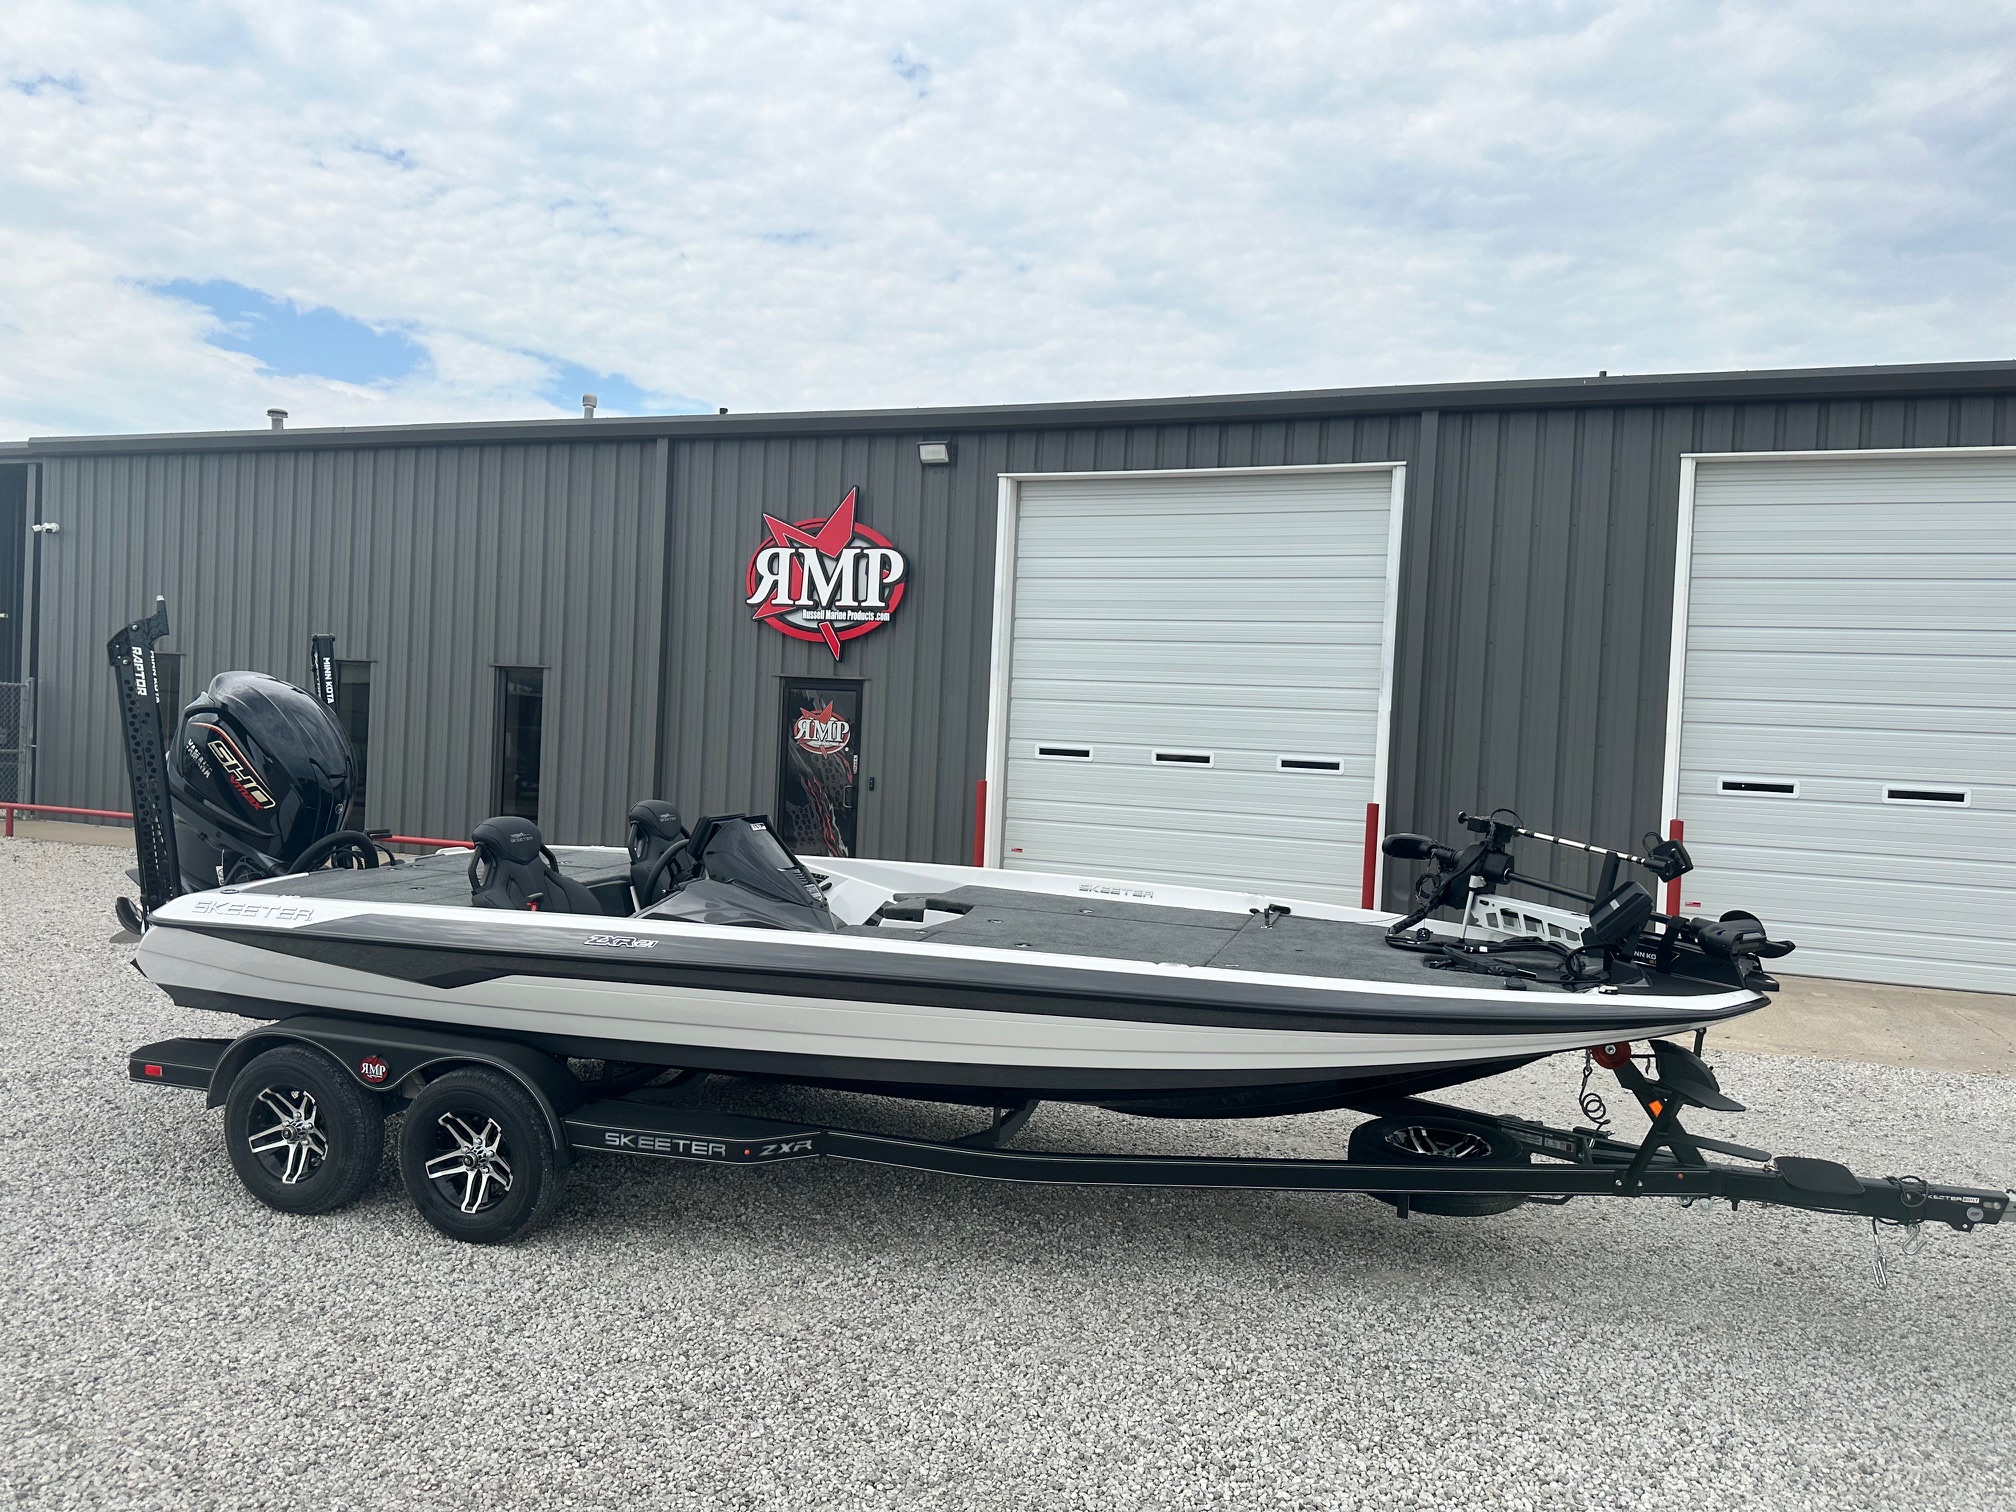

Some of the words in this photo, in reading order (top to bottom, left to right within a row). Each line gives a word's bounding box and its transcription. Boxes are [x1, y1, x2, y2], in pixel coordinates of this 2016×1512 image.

[802, 609, 825, 620] Russell
[825, 610, 847, 621] Marine
[131, 646, 148, 696] RAPTOR
[322, 657, 333, 681] MINN
[325, 681, 335, 704] KOTA
[185, 738, 213, 779] YAMAHA
[207, 740, 276, 809] SHO
[510, 836, 534, 844] SKEETER
[1079, 884, 1154, 898] SKEETER
[191, 900, 315, 922] SKEETER
[604, 1132, 727, 1157] SKEETER
[757, 1139, 813, 1157] ZXR
